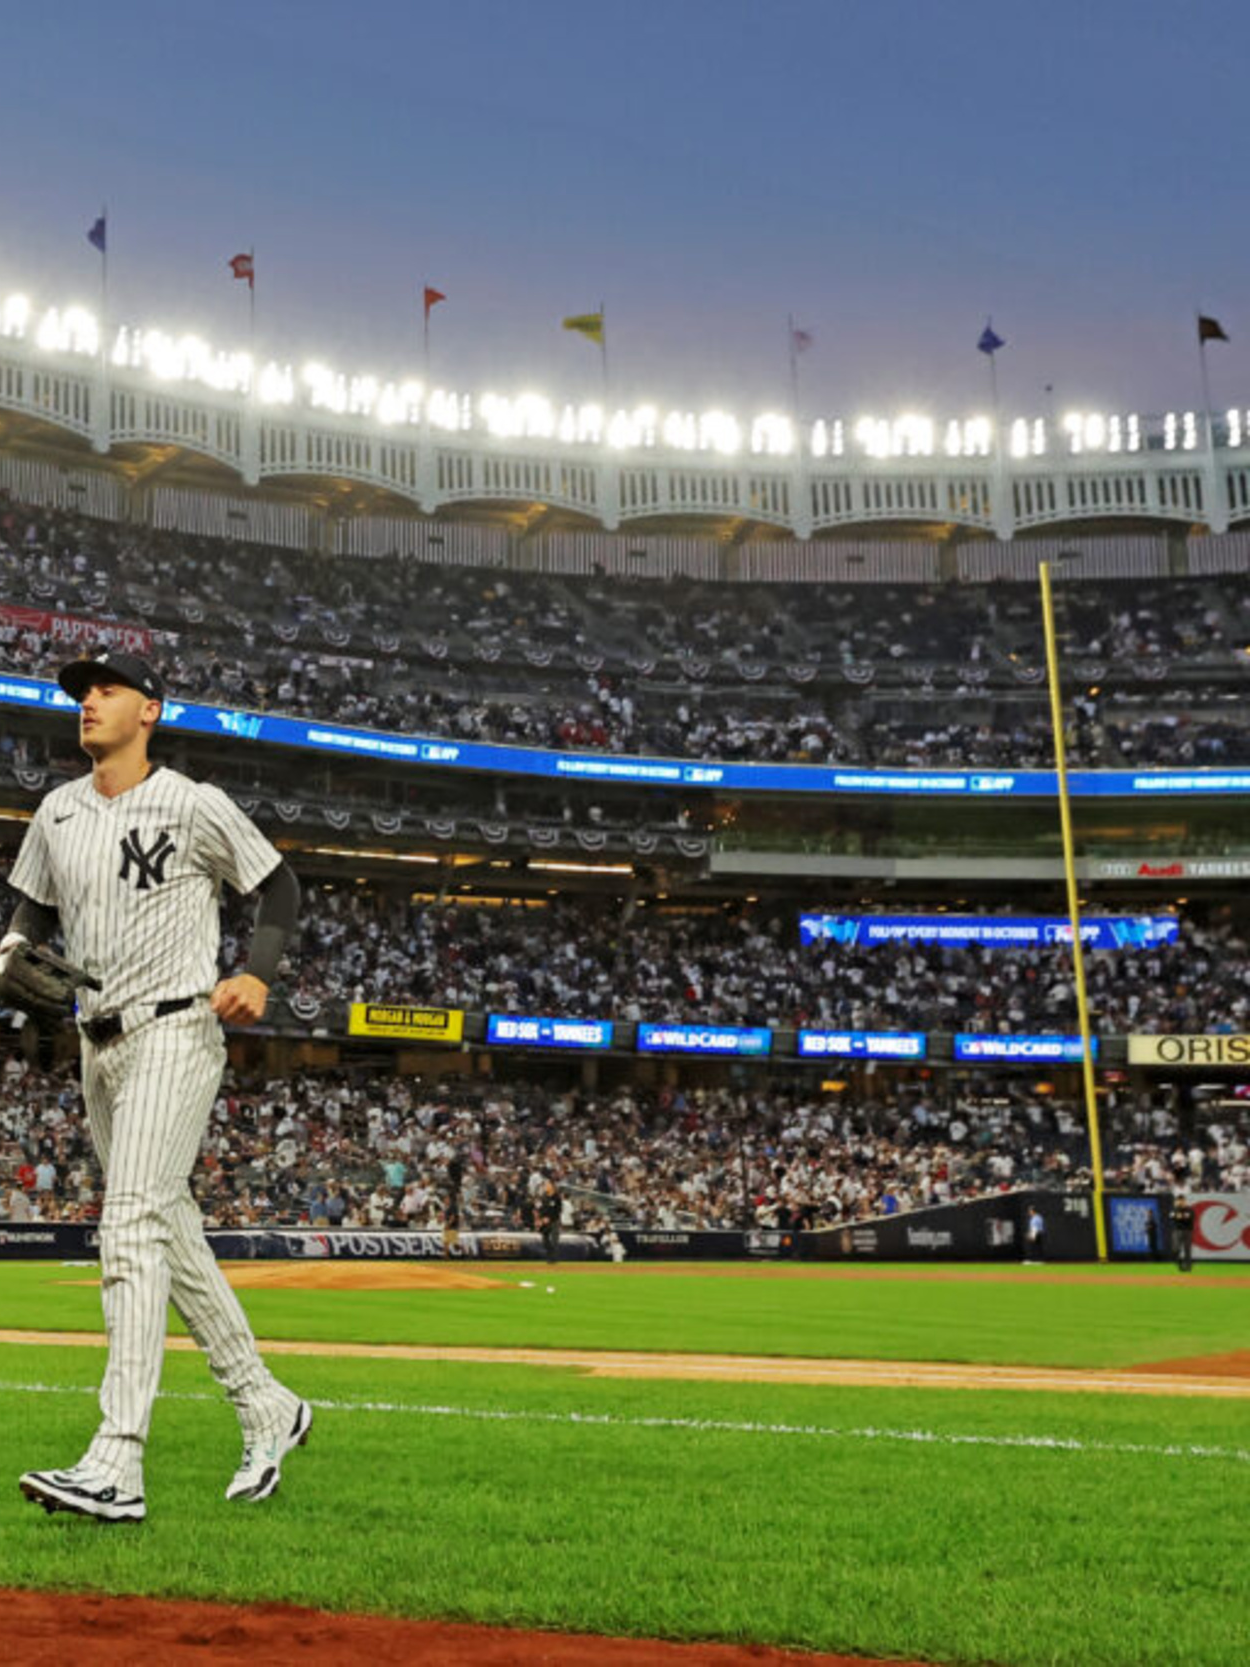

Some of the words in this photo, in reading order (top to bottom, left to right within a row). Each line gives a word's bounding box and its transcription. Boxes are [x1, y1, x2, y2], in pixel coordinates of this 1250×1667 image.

[119, 827, 177, 890] NY
[1137, 863, 1184, 877] Audi
[496, 1020, 518, 1039] RED
[518, 1021, 539, 1040] SOX
[803, 1035, 826, 1052] RED
[827, 1036, 851, 1053] SOX
[1156, 1036, 1250, 1062] ORIS
